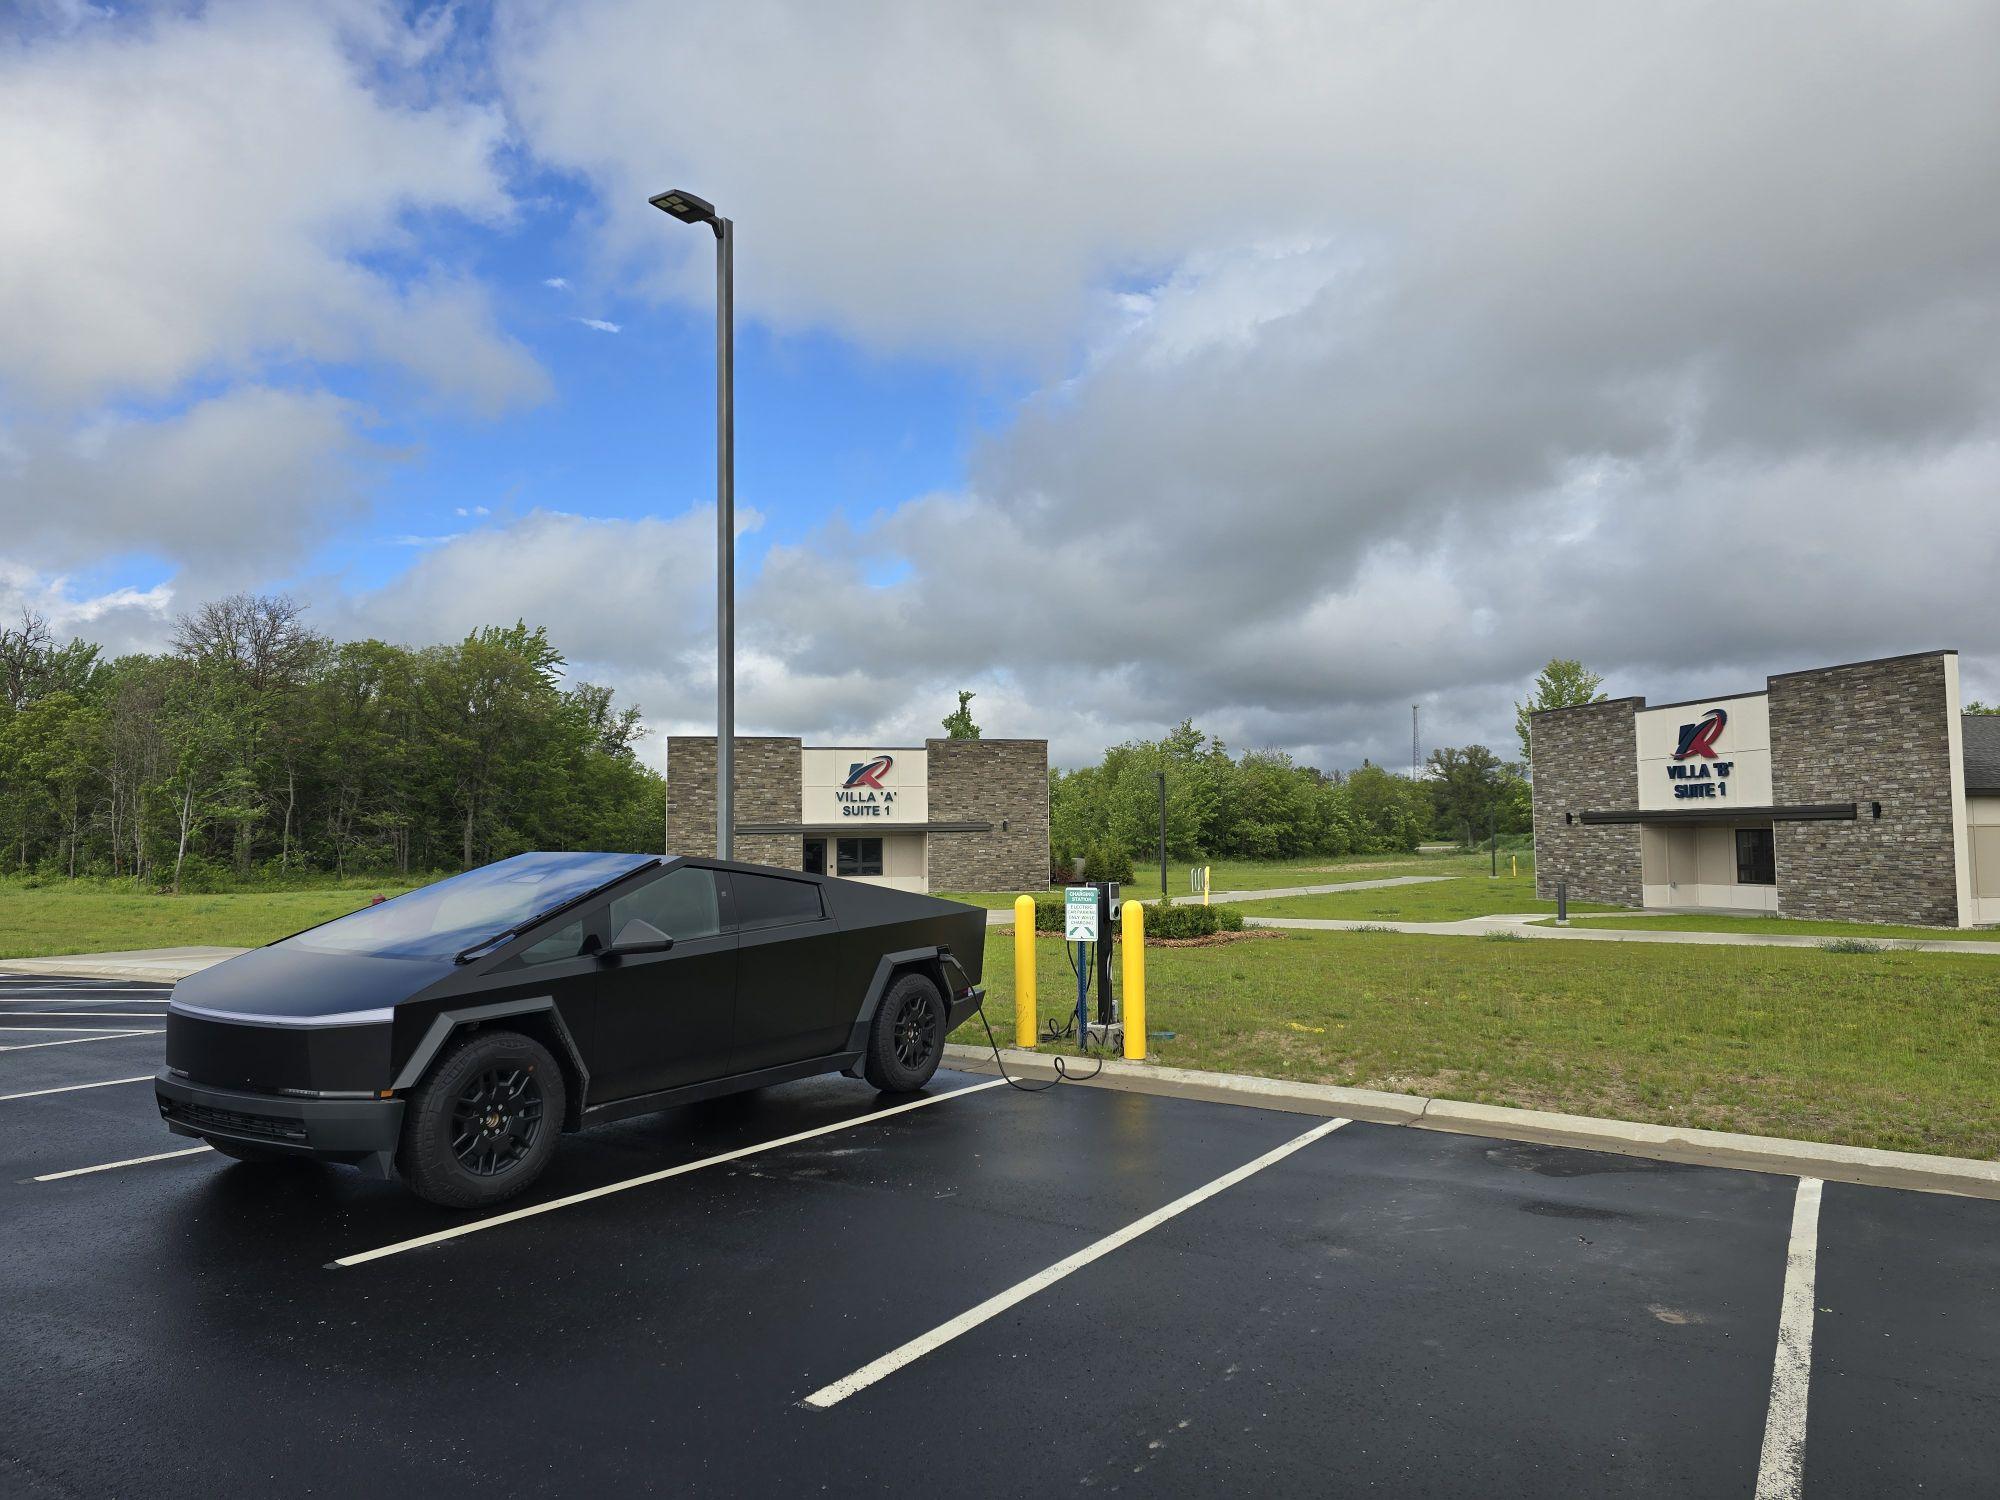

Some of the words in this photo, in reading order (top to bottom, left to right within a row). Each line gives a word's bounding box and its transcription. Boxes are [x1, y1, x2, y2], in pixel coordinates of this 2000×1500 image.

[1667, 764, 1711, 779] VILLA
[836, 792, 876, 802] VILLA
[1674, 783, 1716, 799] SUITE
[1718, 782, 1726, 796] 1
[843, 805, 880, 816] SUITE
[885, 805, 890, 815] 1
